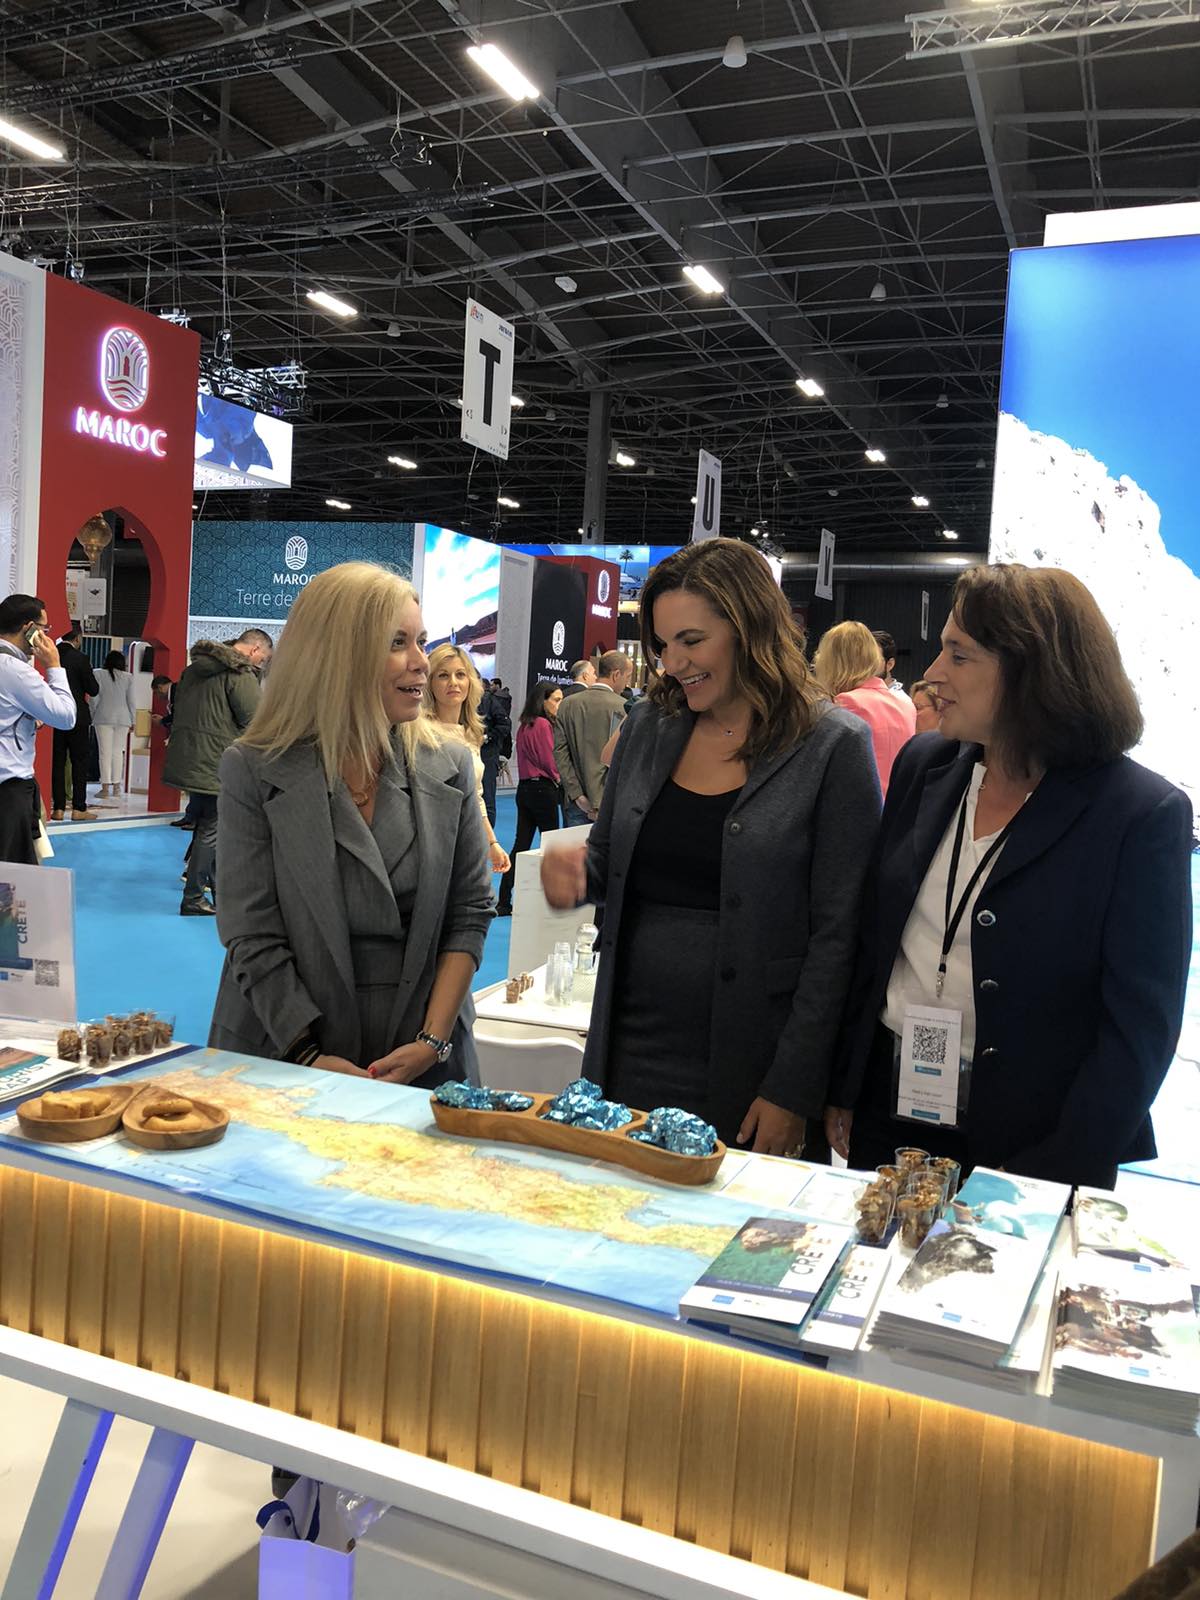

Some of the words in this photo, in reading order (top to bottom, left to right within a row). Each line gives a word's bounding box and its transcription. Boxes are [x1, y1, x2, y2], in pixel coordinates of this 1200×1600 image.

[479, 338, 501, 427] T
[75, 405, 168, 457] MAROC
[702, 473, 716, 532] U
[236, 588, 272, 606] Terre
[274, 588, 293, 607] de
[545, 658, 569, 672] MAROC
